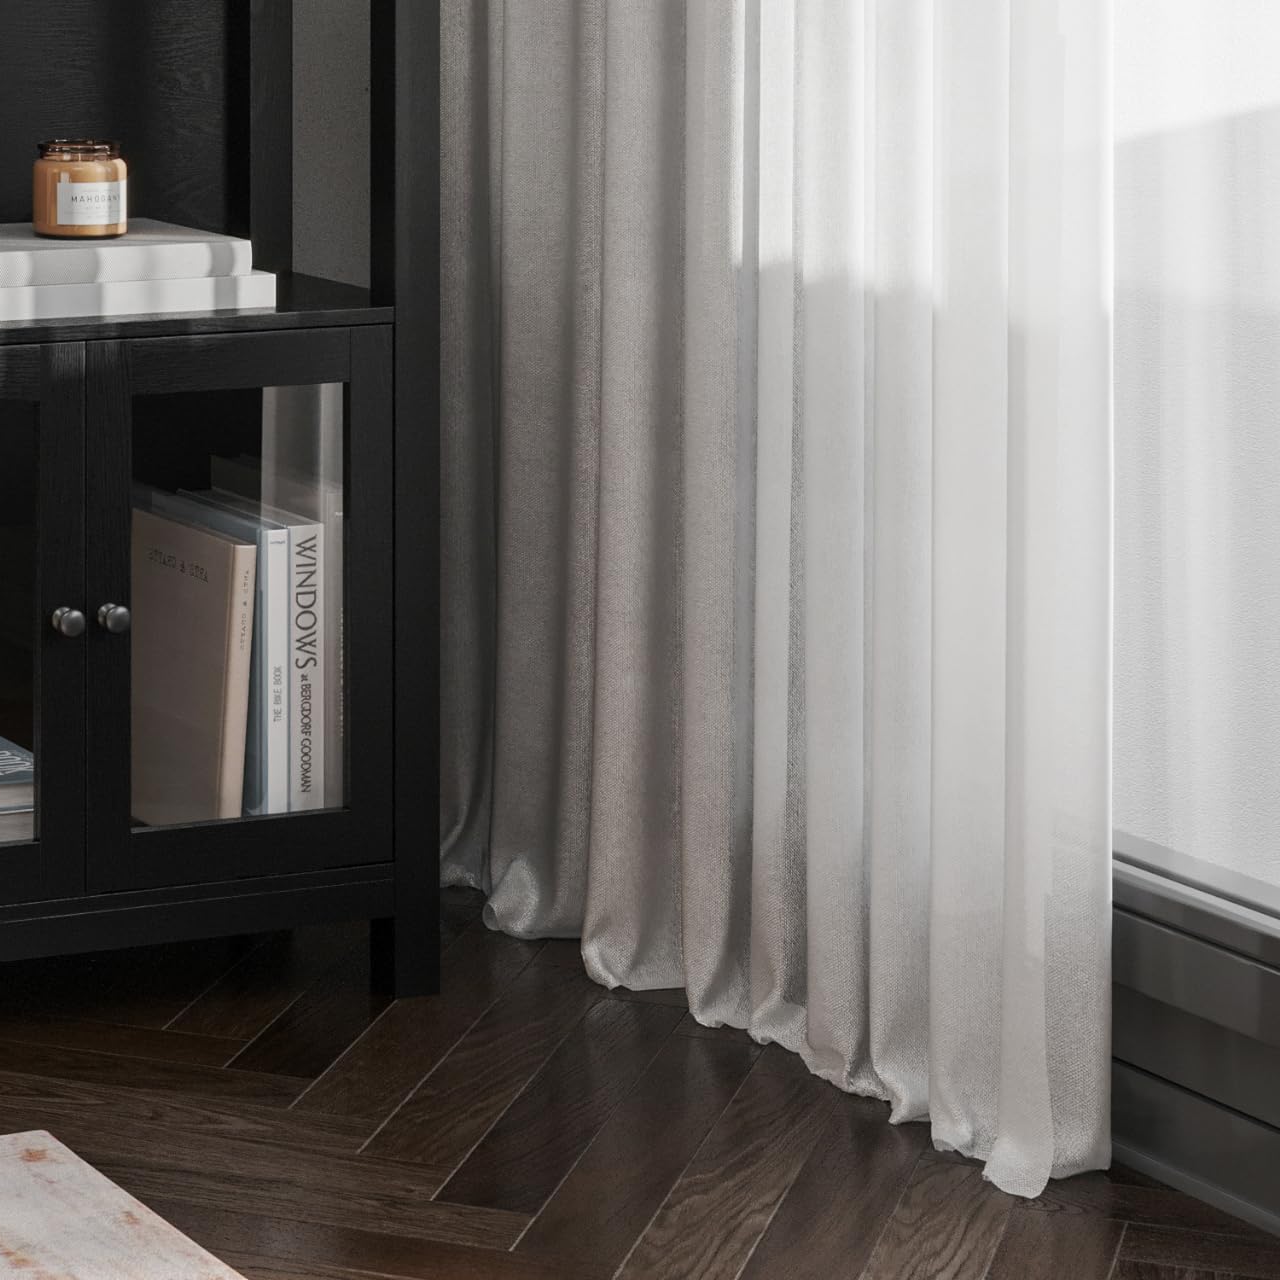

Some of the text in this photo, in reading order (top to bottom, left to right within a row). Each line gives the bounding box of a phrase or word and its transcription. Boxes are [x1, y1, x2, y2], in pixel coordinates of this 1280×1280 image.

[295, 535, 317, 669] WINDOWS
[273, 666, 282, 722] THE BIKE BOOK
[301, 683, 312, 736] BERGDORF
[301, 738, 312, 793] GOODMAN
